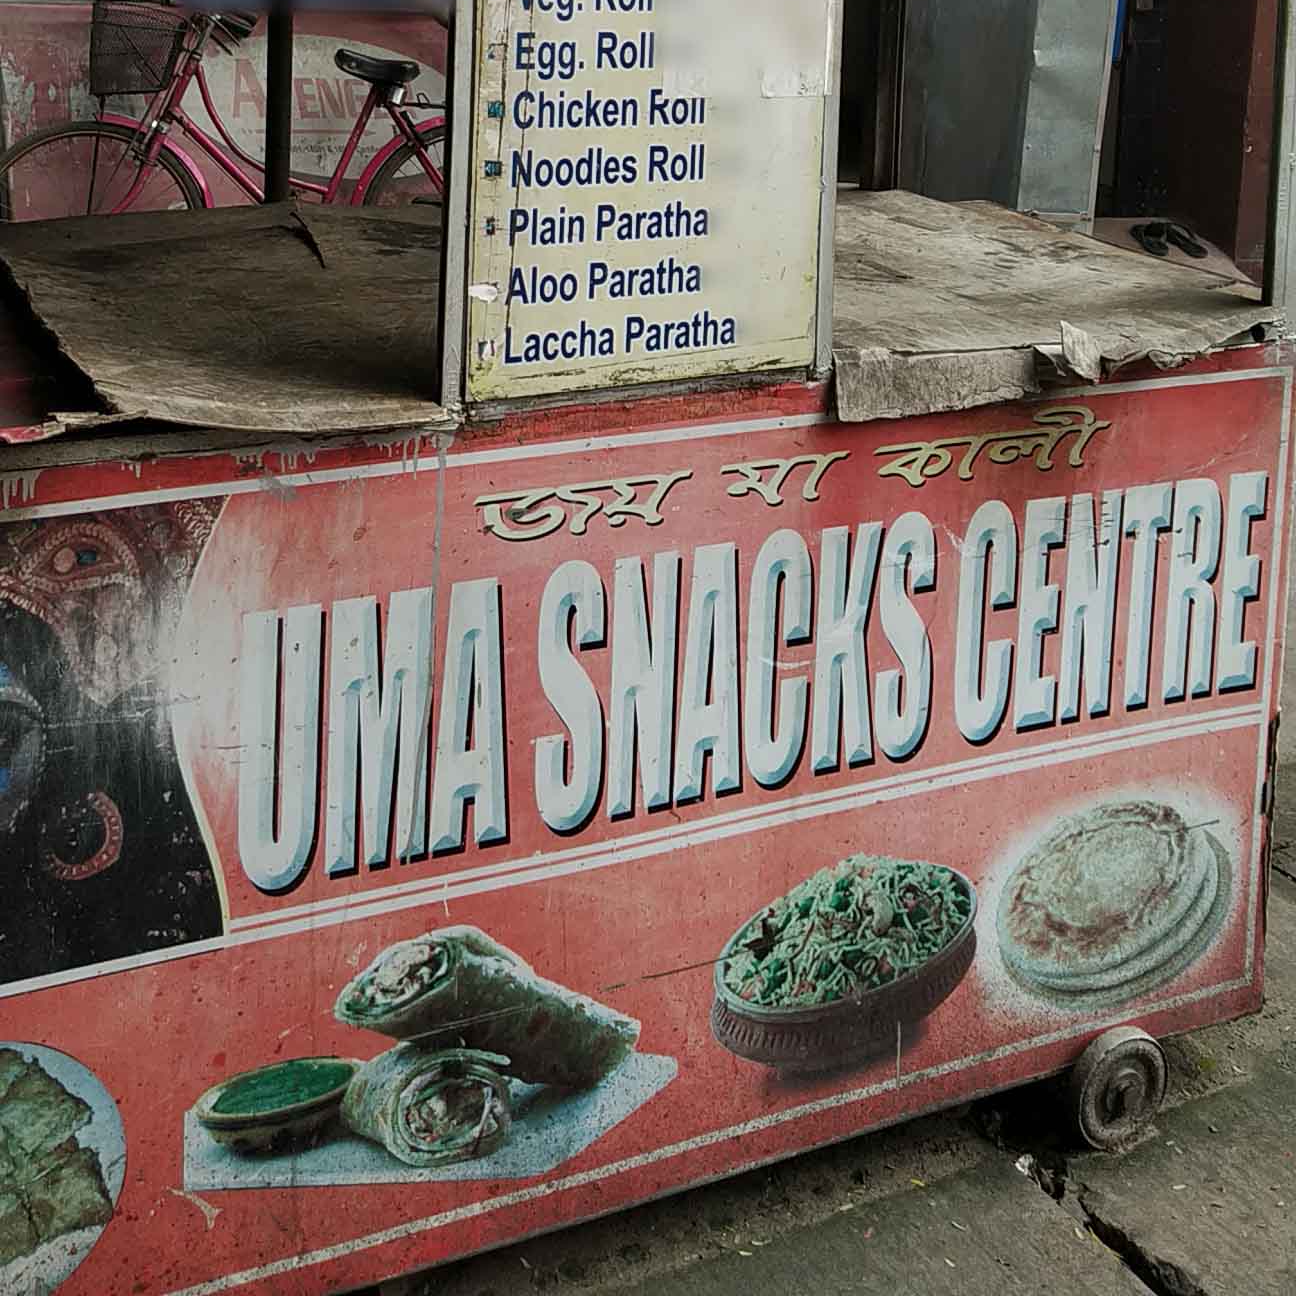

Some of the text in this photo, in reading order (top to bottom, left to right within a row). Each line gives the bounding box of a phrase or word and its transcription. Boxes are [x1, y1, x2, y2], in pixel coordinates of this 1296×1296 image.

[514, 30, 655, 82] Egg. Roll
[512, 88, 638, 131] Chicken
[648, 88, 705, 126] Roll
[510, 147, 638, 189] Noodles
[647, 144, 706, 183] Roll
[508, 207, 586, 247] Plain
[595, 200, 710, 242] Paratha
[504, 256, 702, 308] Aloo Paratha
[503, 310, 736, 365] Laccha Paratha
[473, 405, 1111, 542] জয় মা কালী
[237, 469, 1269, 895] UMA SNACKS CENTRE
